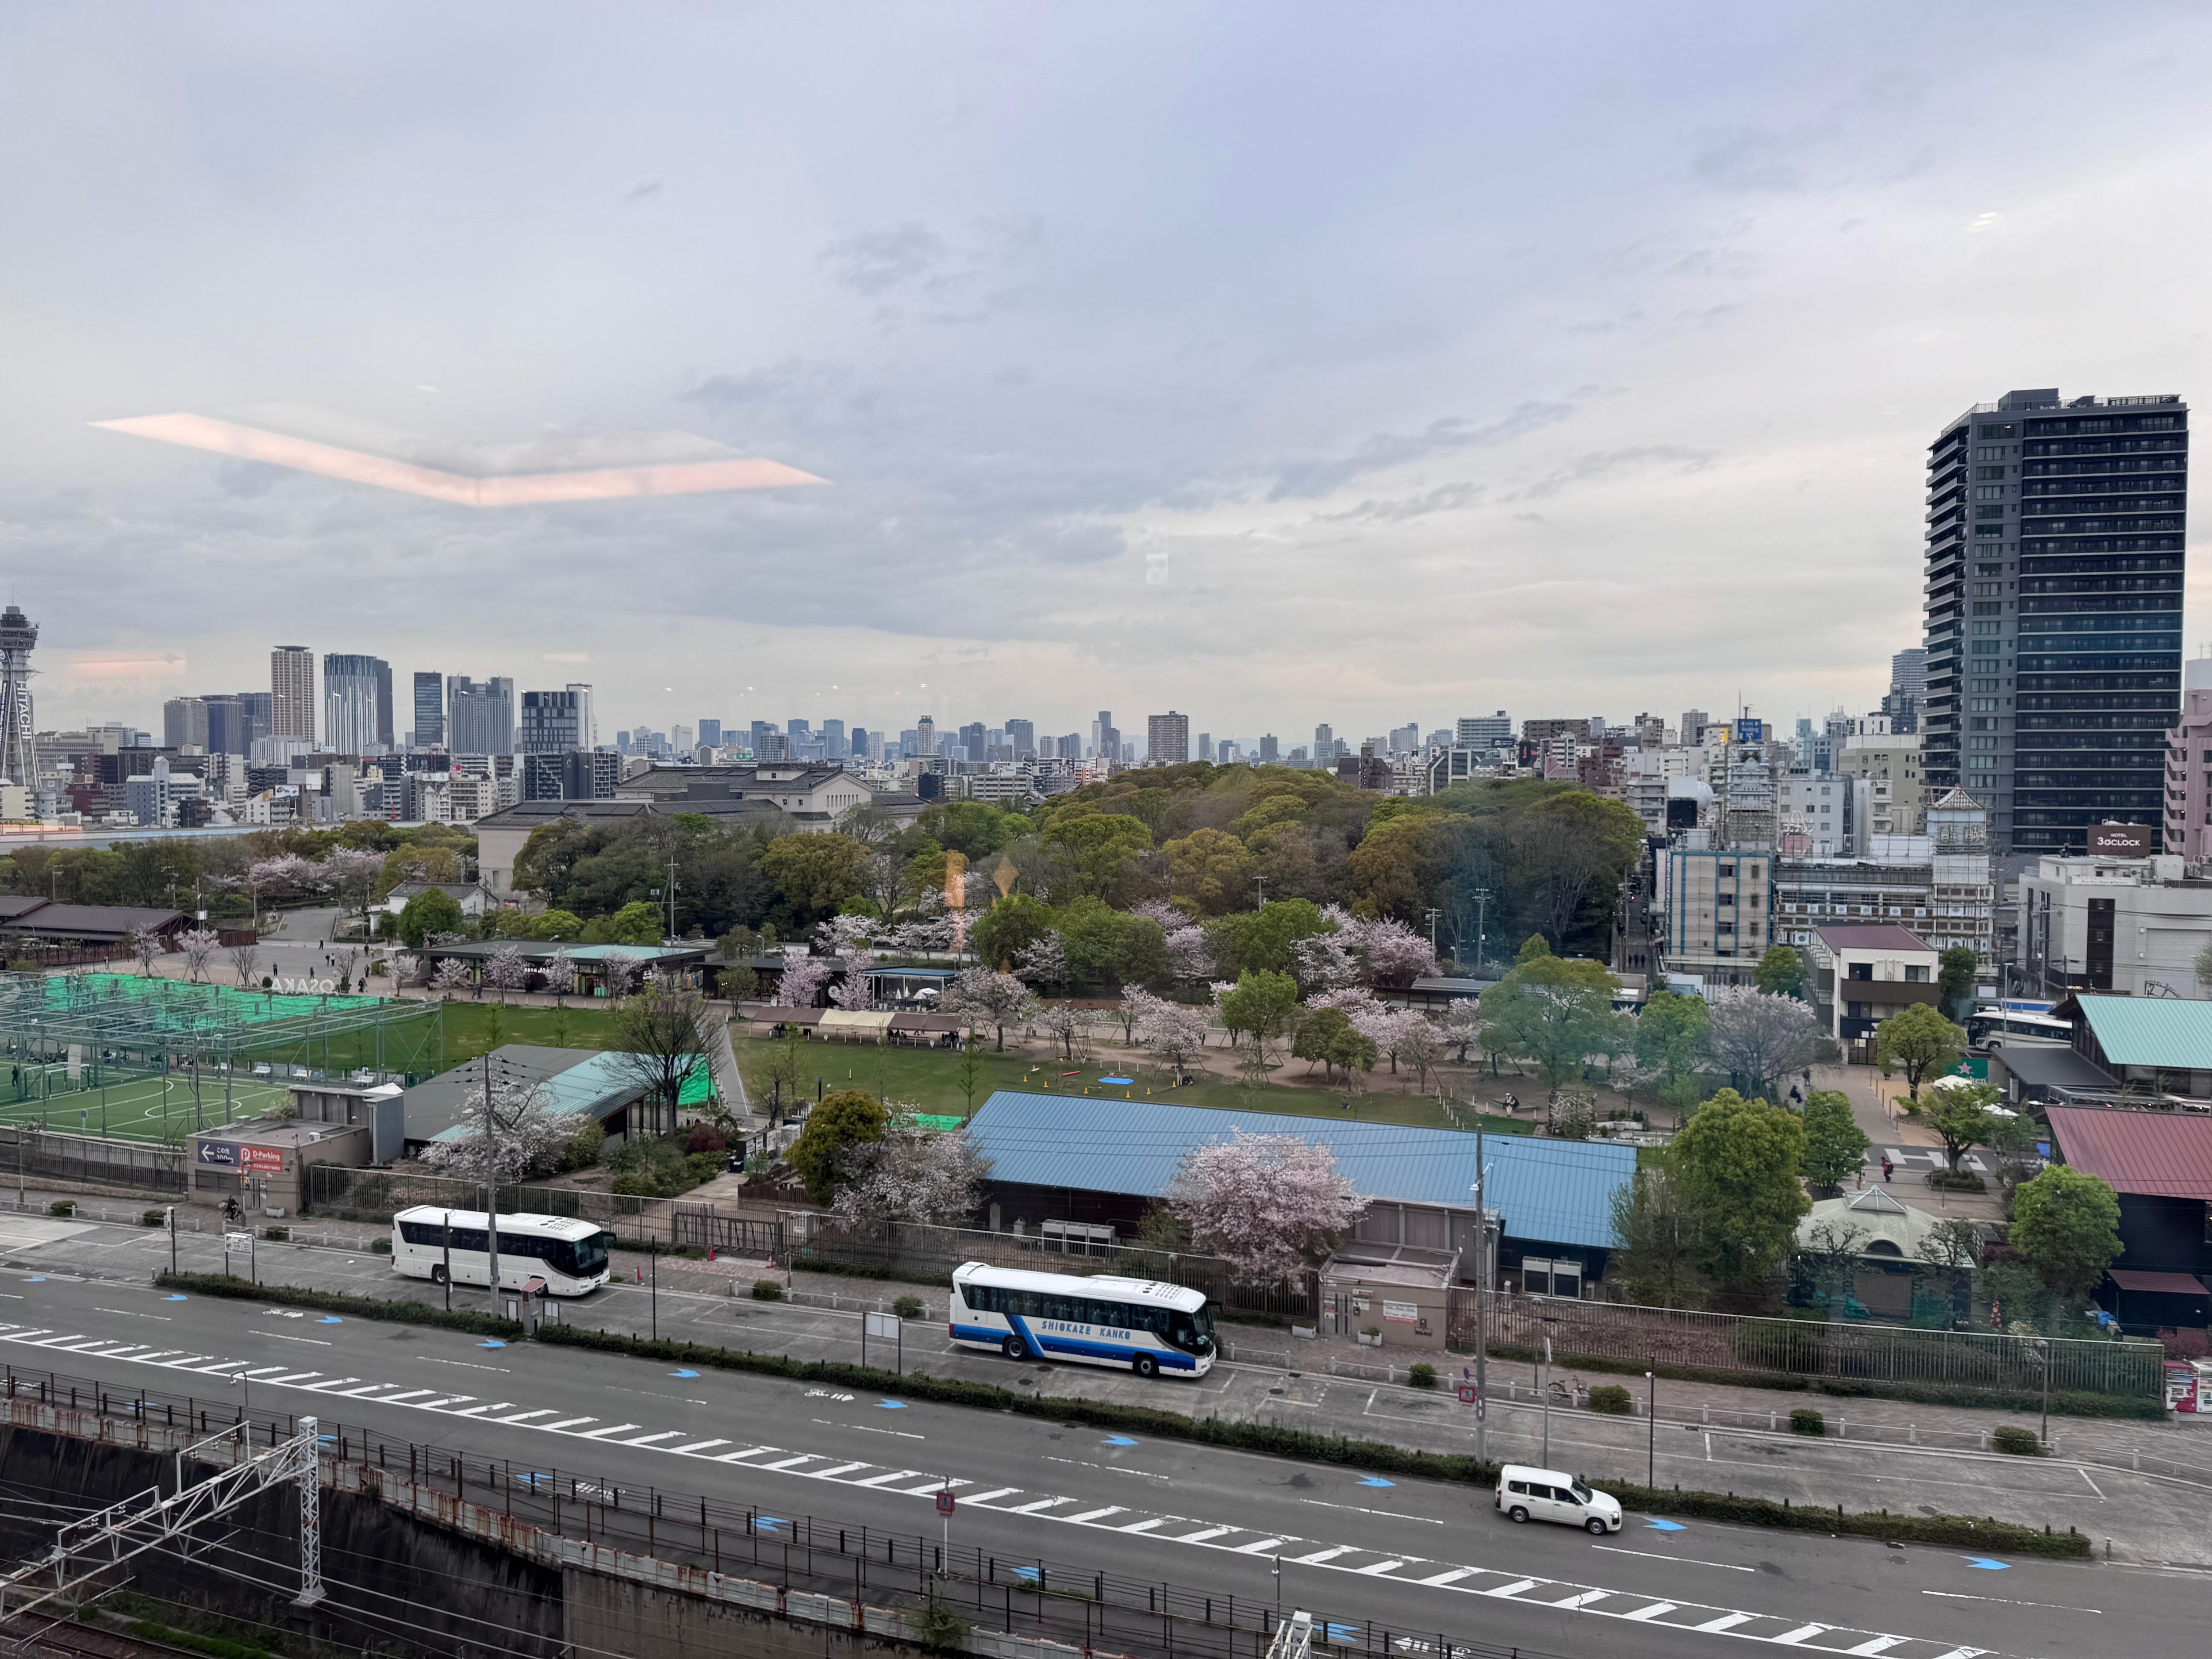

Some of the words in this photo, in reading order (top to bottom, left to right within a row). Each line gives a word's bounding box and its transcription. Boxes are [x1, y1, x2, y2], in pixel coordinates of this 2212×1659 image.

[16, 680, 31, 739] HITACHI
[253, 1150, 280, 1161] D-Parking
[1042, 1321, 1091, 1335] SHIOKAZE
[1100, 1328, 1130, 1340] KANKO
